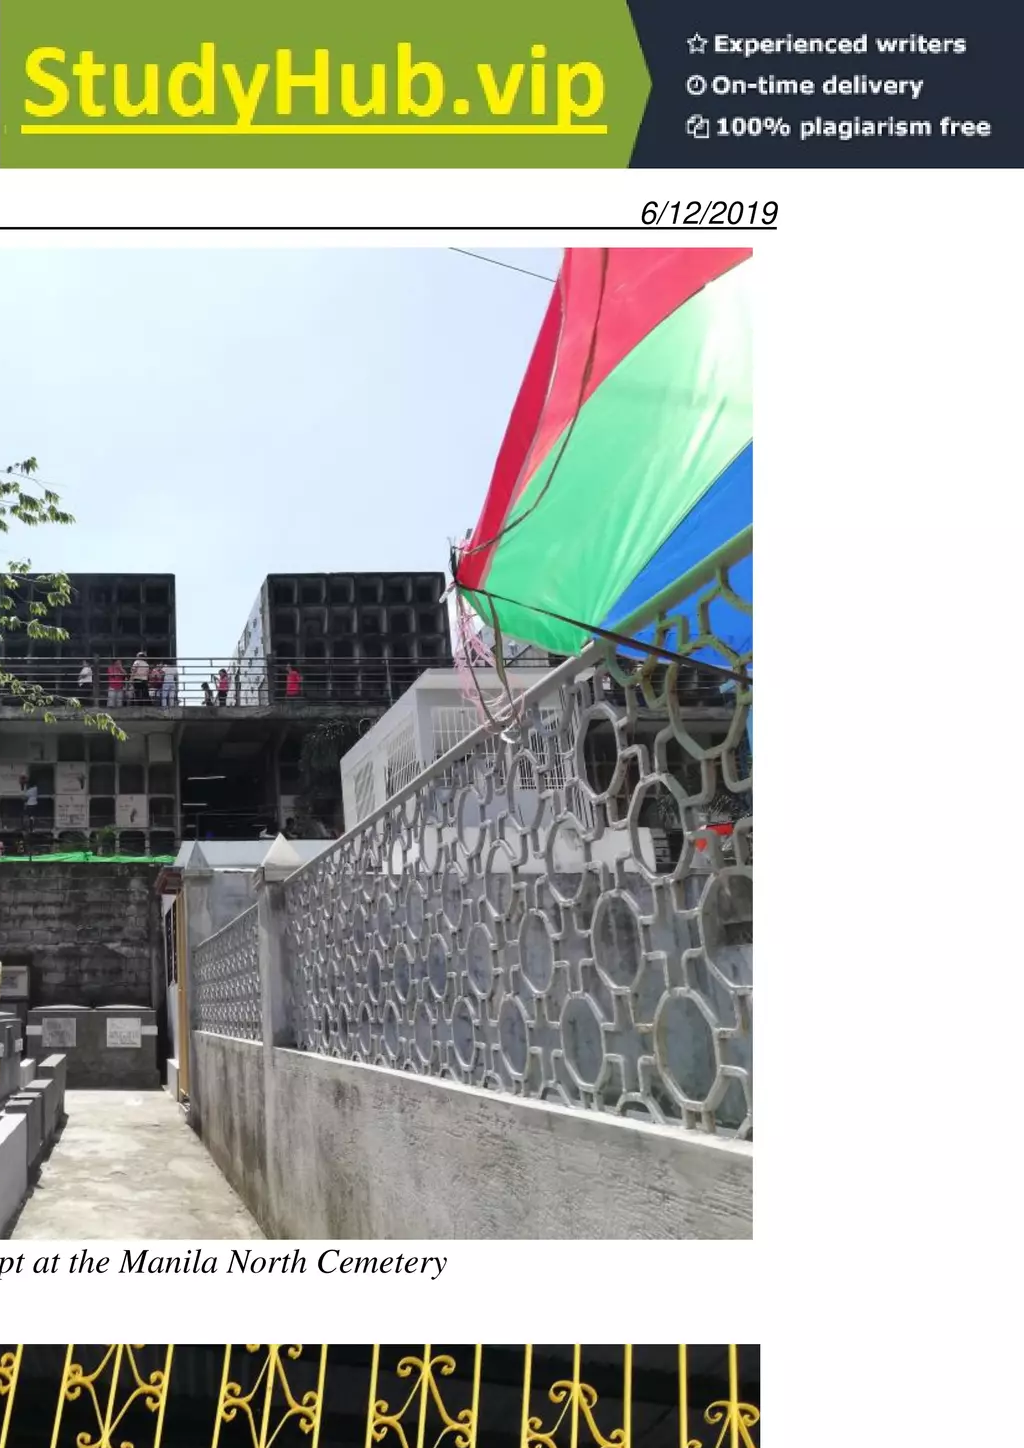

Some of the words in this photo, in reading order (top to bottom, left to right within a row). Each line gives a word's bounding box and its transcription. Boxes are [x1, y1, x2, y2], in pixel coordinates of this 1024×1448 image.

[642, 201, 778, 225] 6/12/2019
[33, 1254, 60, 1274] at
[69, 1249, 109, 1274] the
[118, 1249, 217, 1274] Manila
[226, 1249, 306, 1274] North
[318, 1250, 447, 1280] Cemetery
